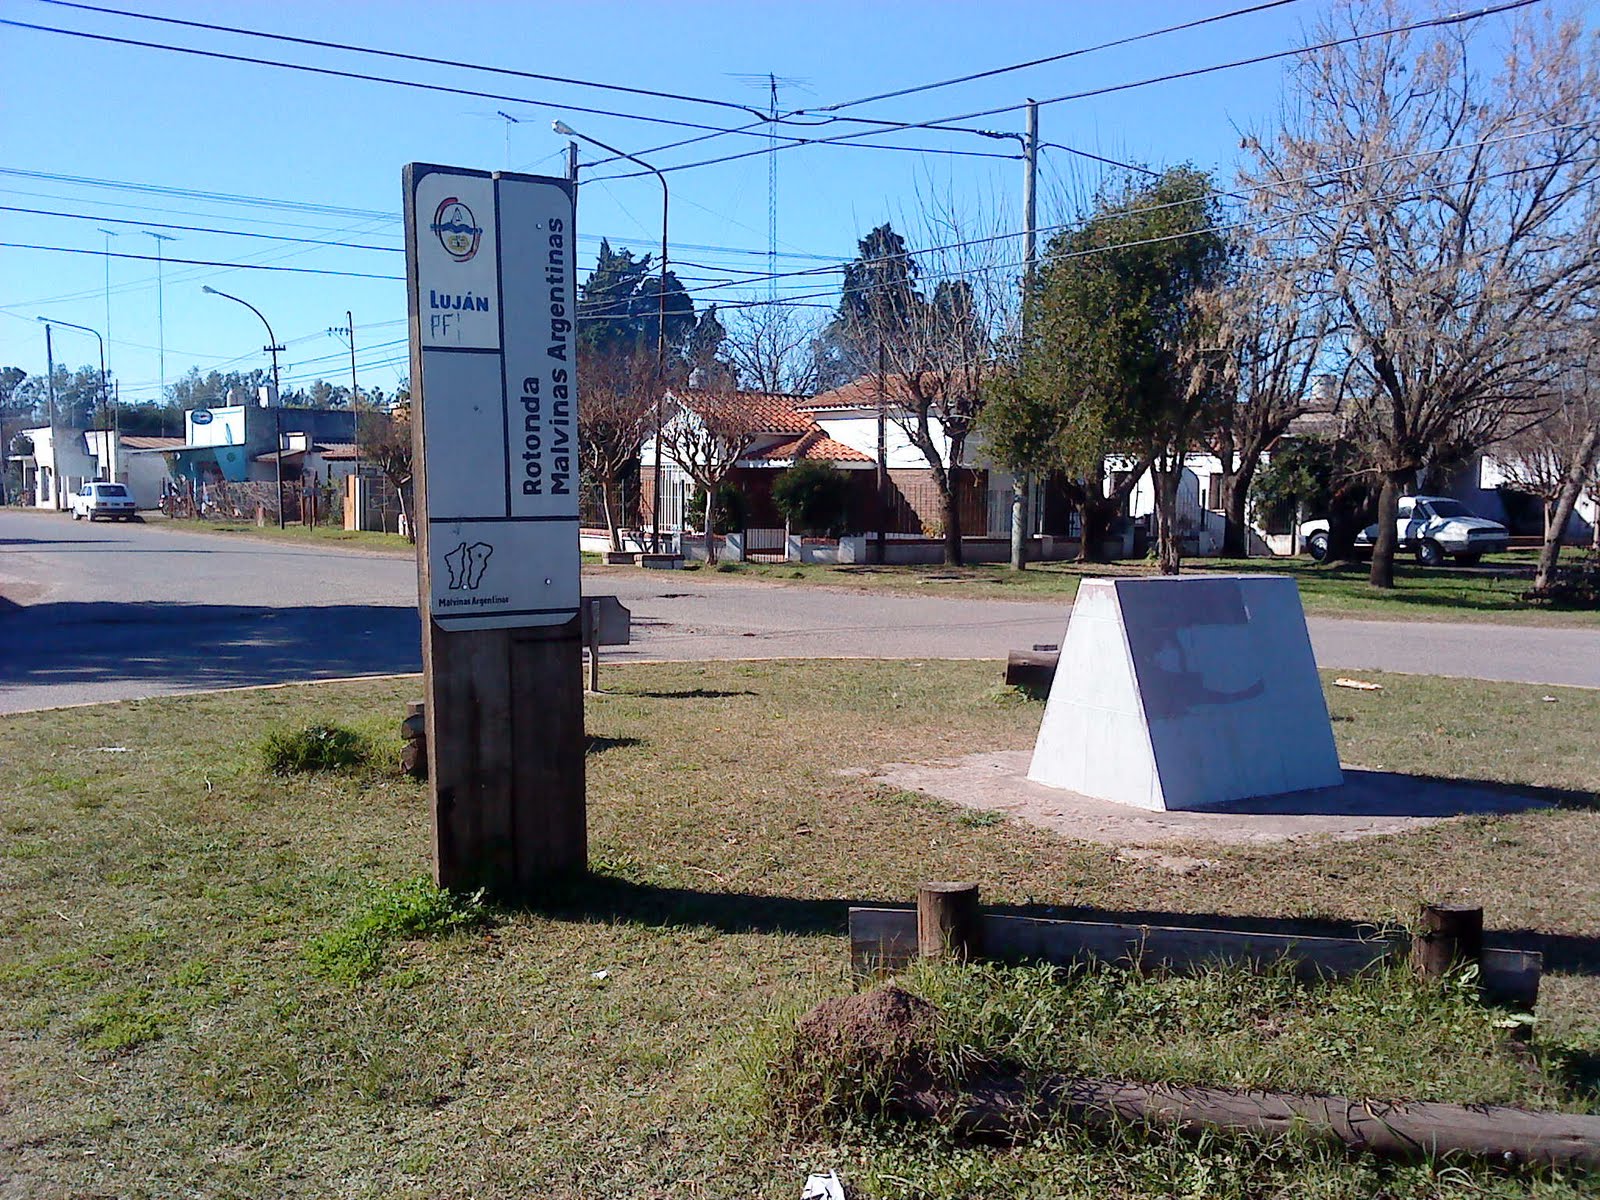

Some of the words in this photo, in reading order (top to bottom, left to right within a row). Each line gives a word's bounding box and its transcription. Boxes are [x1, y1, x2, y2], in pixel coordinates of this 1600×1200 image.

[430, 290, 489, 312] LUJÁN
[545, 217, 572, 362] Argentinas
[520, 376, 542, 495] Rotonda
[548, 368, 570, 495] Malvinas
[438, 598, 471, 607] Malvinas
[472, 595, 509, 607] Argentinas
